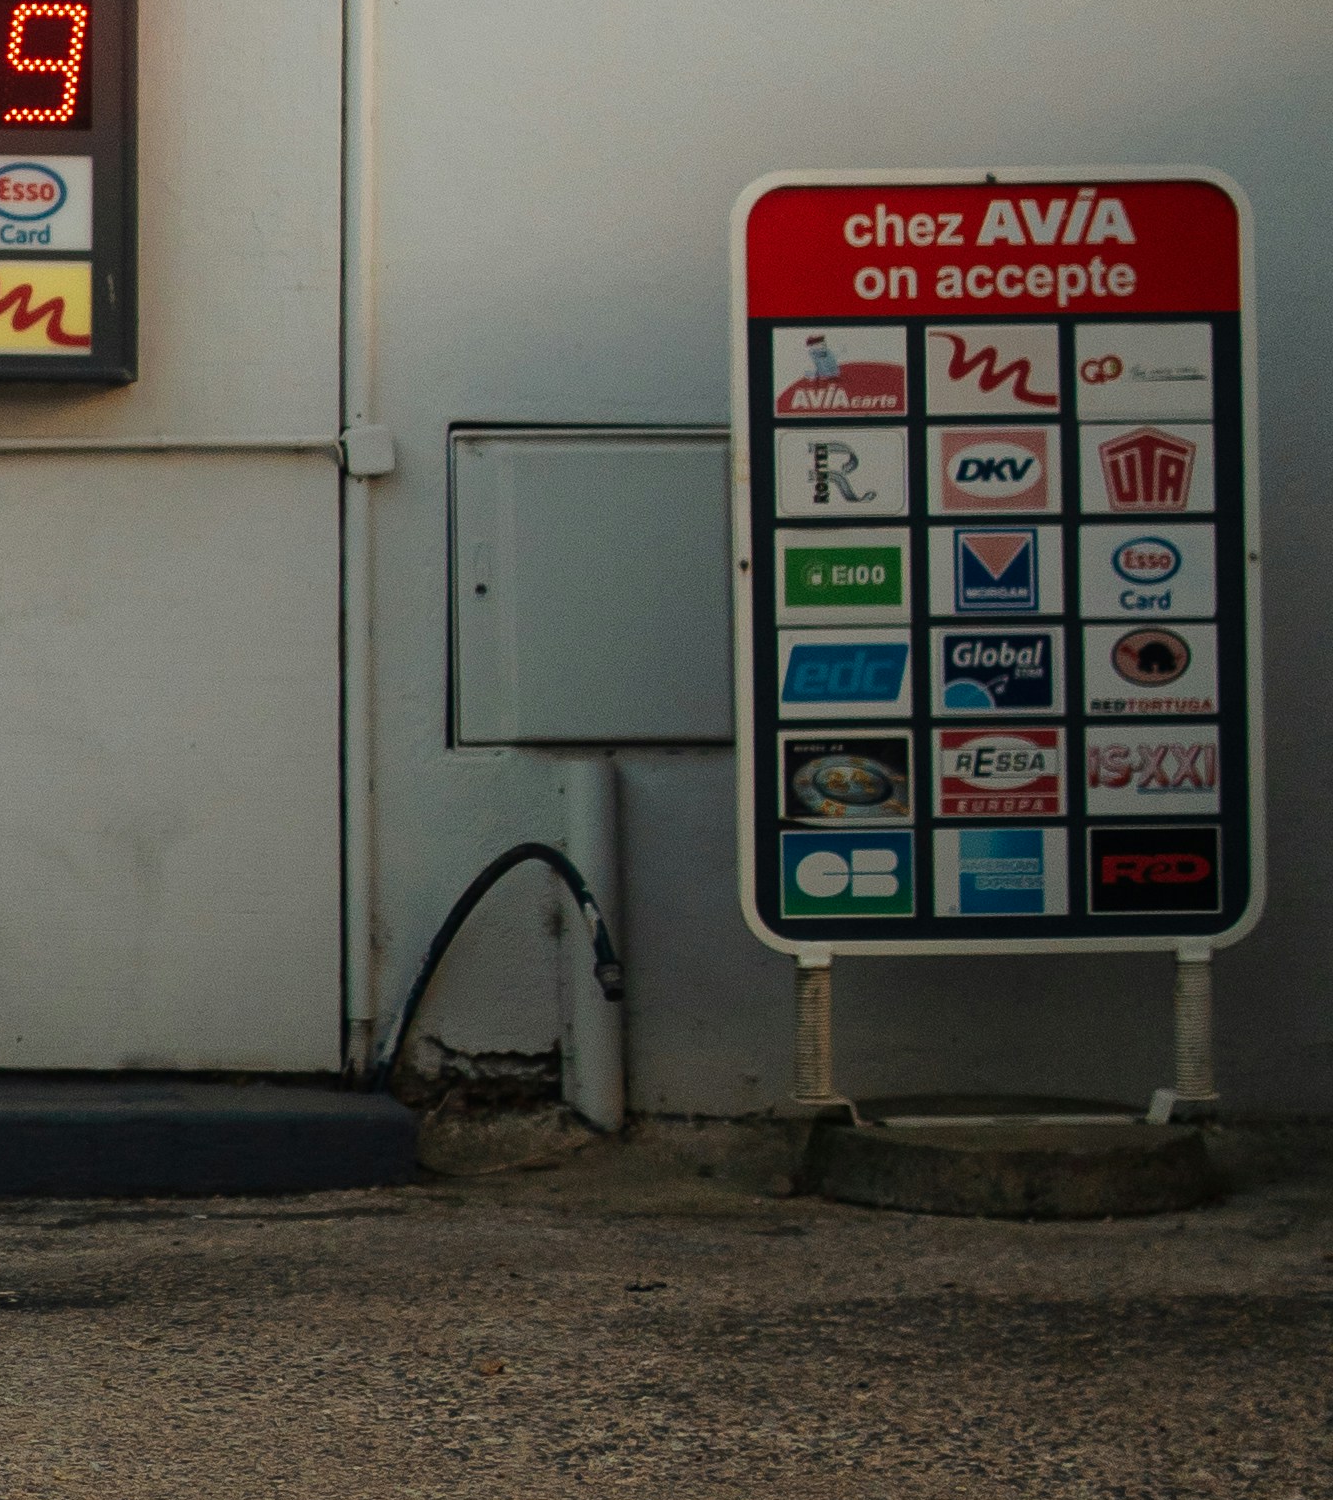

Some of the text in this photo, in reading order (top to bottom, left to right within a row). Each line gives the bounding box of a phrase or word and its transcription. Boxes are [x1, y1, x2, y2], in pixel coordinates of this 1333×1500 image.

[843, 189, 1136, 248] chez AVIA
[0, 223, 52, 246] Card
[854, 257, 1137, 307] on accepte
[955, 457, 1035, 482] DKV
[1122, 548, 1173, 571] Esso
[1120, 590, 1172, 611] Card
[952, 640, 1043, 669] Global
[957, 797, 1044, 815] EUROPA
